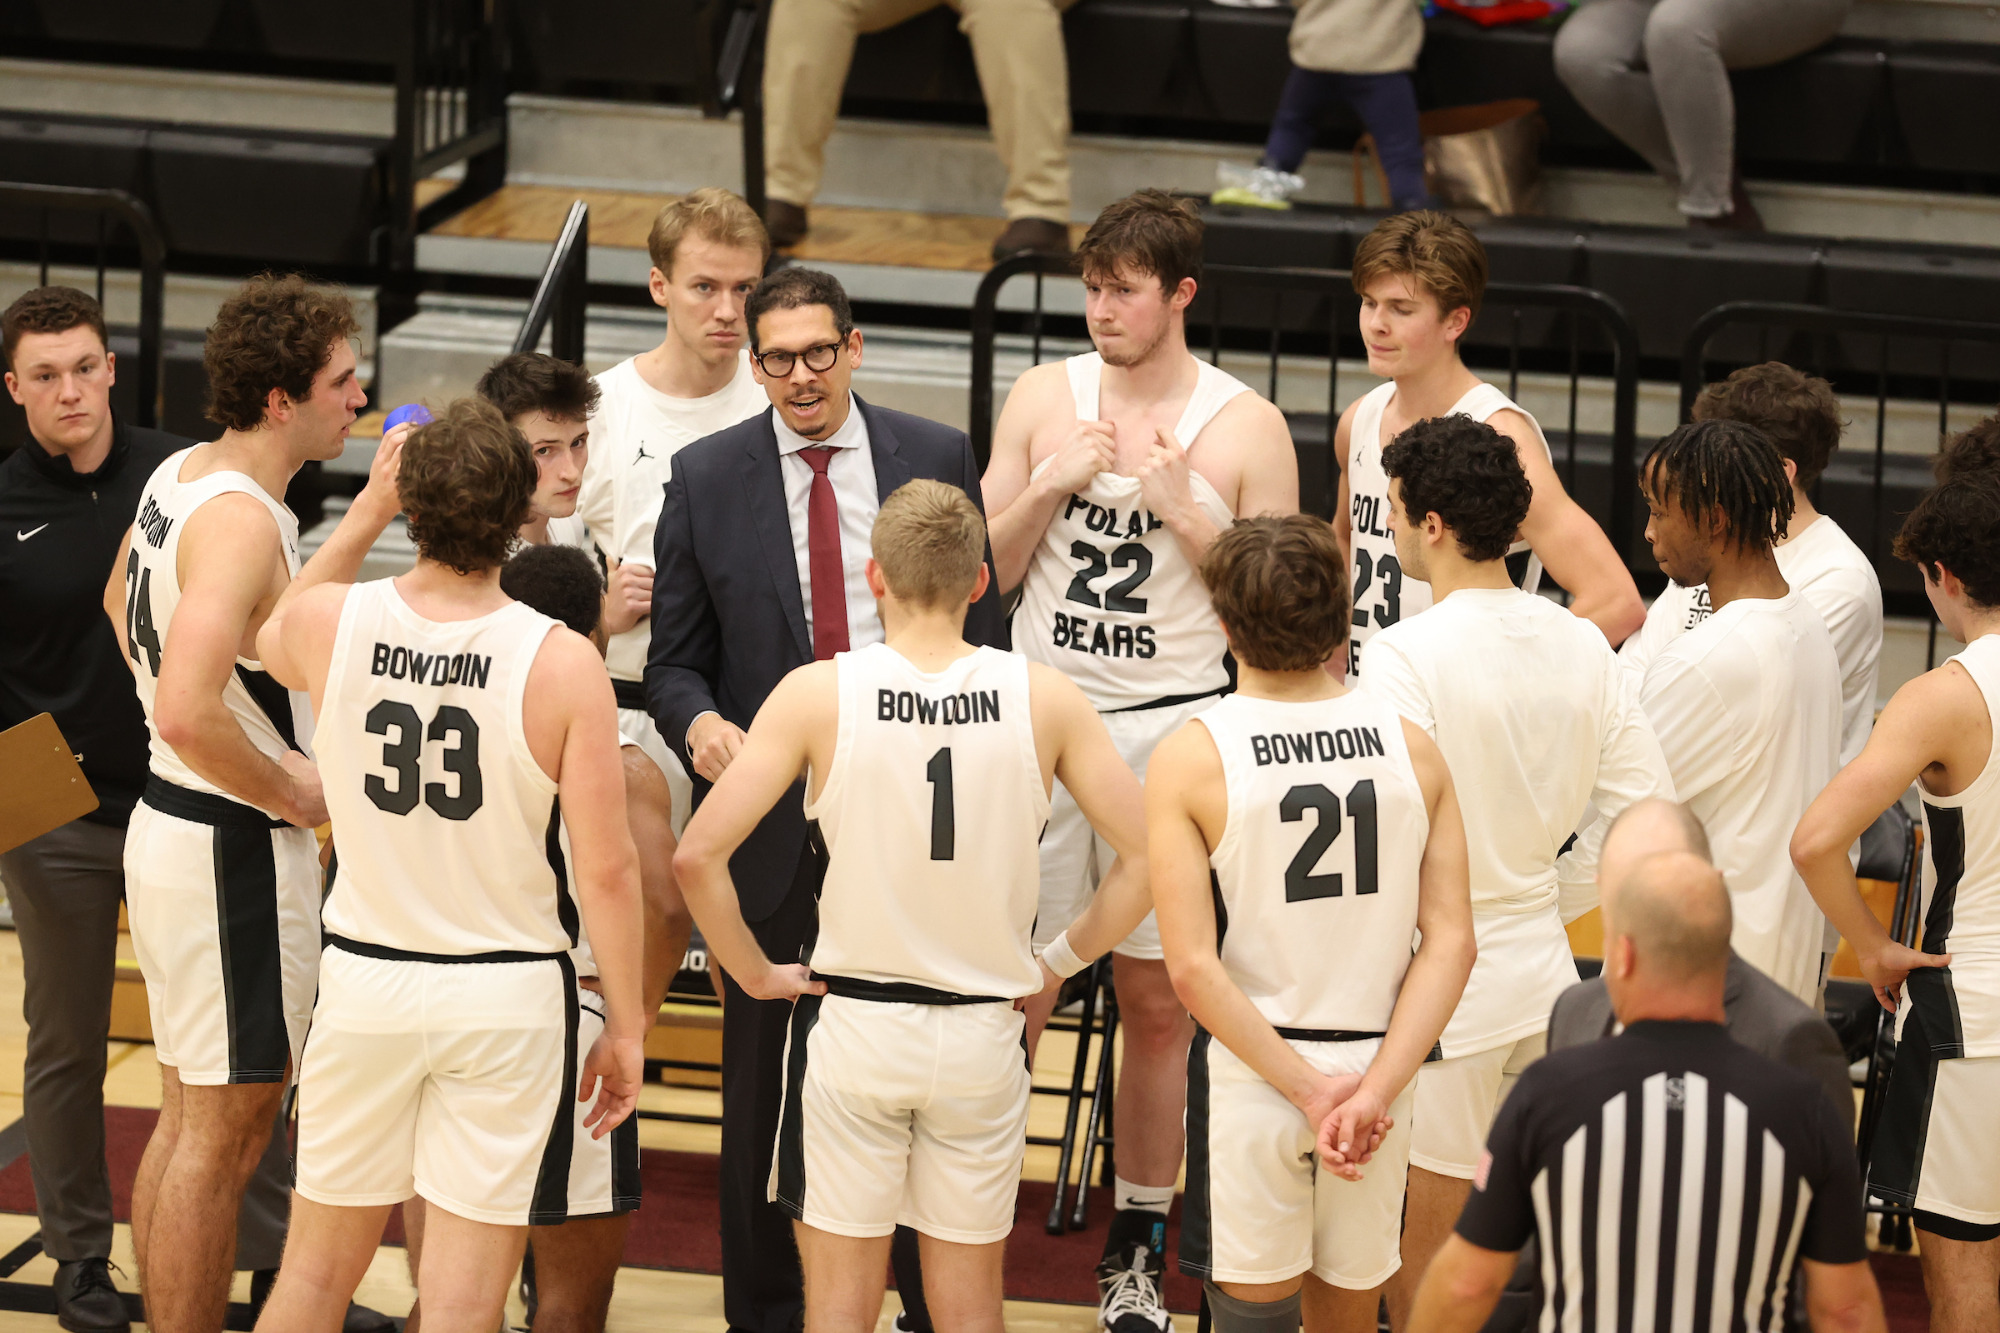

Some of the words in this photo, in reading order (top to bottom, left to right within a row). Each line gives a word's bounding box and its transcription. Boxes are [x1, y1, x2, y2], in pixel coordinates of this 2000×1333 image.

[126, 547, 162, 678] 24
[1065, 539, 1153, 614] 22
[1352, 547, 1402, 629] 23
[371, 643, 492, 690] BOWDOIN
[1053, 611, 1156, 659] BEARS
[878, 689, 1001, 726] BOWDOIN
[364, 699, 483, 821] 33
[1251, 727, 1386, 767] BOWDOIN
[926, 747, 955, 862] 1
[1279, 779, 1379, 904] 21
